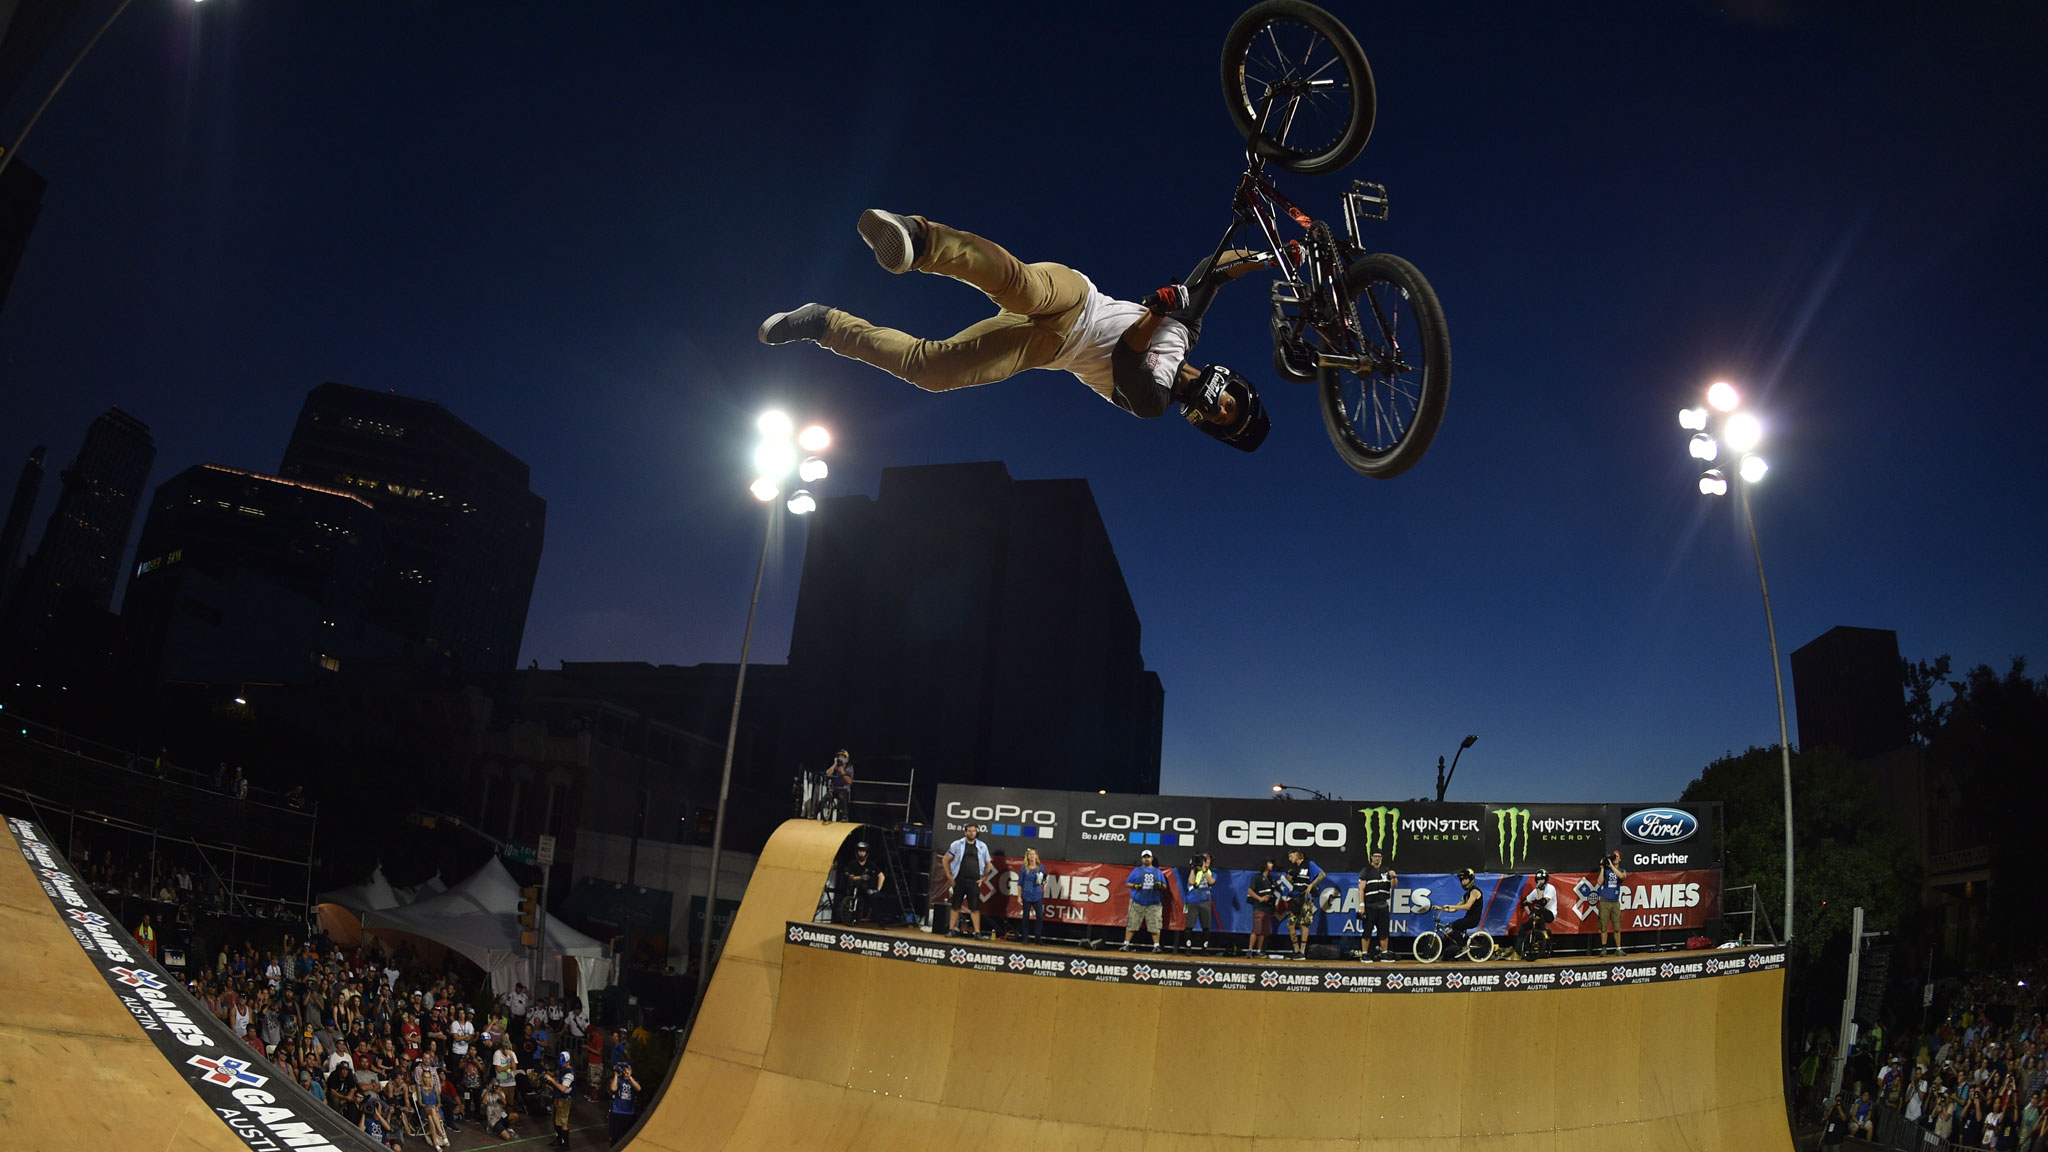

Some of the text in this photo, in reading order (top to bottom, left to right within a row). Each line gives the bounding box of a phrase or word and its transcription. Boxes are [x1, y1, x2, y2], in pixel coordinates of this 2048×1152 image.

[946, 802, 1056, 824] GoPro
[1081, 810, 1196, 832] GoPro
[1402, 817, 1480, 832] MONSTER
[1532, 818, 1601, 832] MONSTER
[1638, 813, 1684, 837] Ford
[1082, 832, 1091, 840] Be
[1218, 820, 1347, 848] GEICO
[1634, 853, 1688, 865] Go Further
[998, 870, 1111, 904] GMES
[1320, 887, 1432, 914] GAES
[1619, 882, 1700, 910] GAMES
[1020, 905, 1084, 921] STIN
[1342, 919, 1406, 933] AUIN
[1632, 913, 1682, 928] AUSTIN
[84, 924, 134, 964] GAMES
[803, 931, 836, 944] GAMES
[809, 941, 828, 950] AUSTIN
[855, 938, 889, 952] GAMES
[909, 946, 946, 959] GAMES
[966, 953, 1004, 965] GAMES
[916, 956, 937, 964] AUSTIN
[1026, 958, 1065, 972] GAMES
[1718, 958, 1746, 970] GAMES
[1760, 954, 1785, 965] GAMES
[974, 963, 996, 971] AUSTIN
[1088, 964, 1128, 976] GAMES
[1626, 967, 1657, 978] GAMES
[1674, 963, 1703, 974] GAMES
[1151, 968, 1192, 980] GAMES
[1215, 972, 1256, 983] GAMES
[1279, 974, 1319, 986] GAMES
[1463, 975, 1500, 986] GAMES
[1520, 973, 1555, 984] GAMES
[1574, 970, 1607, 981] GAMES
[1342, 976, 1382, 987] GAMES
[1404, 976, 1442, 986] GAMES
[120, 995, 162, 1030] AUSTIN
[136, 988, 215, 1047] GAMES
[231, 1088, 343, 1152] GAM
[216, 1108, 280, 1152] AUSTI
